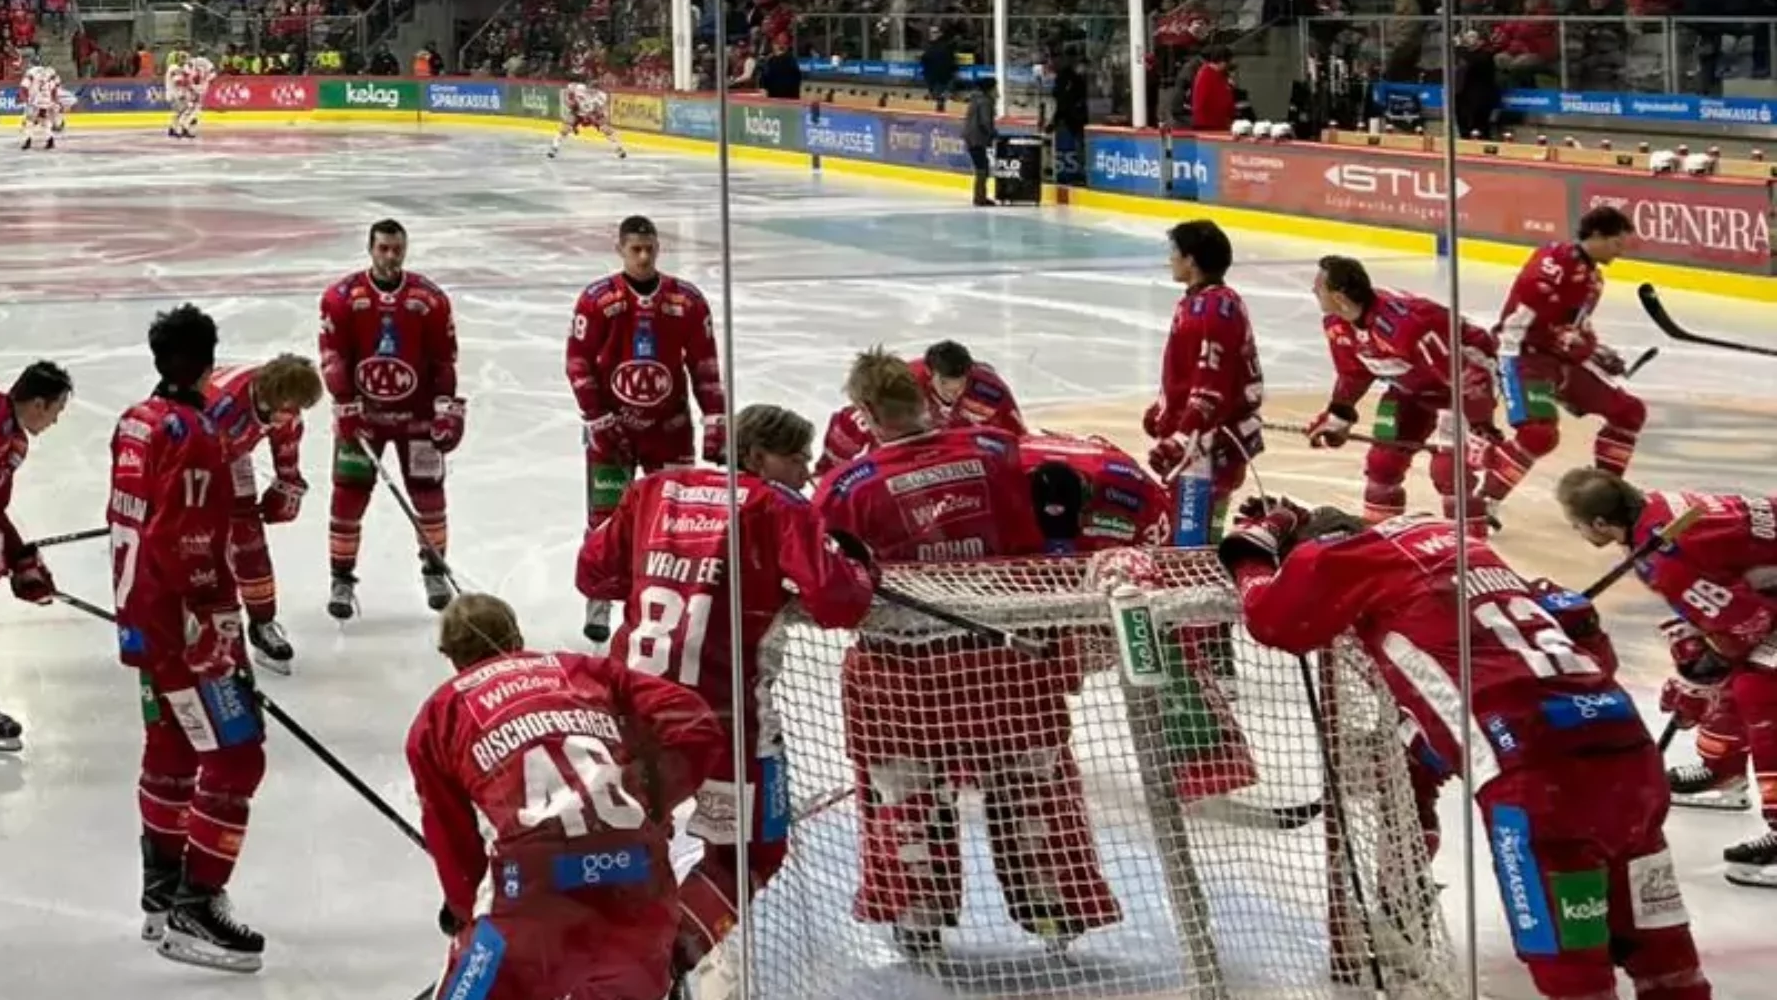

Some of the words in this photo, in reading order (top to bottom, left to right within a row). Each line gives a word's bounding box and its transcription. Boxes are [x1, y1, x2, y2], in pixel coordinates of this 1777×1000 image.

[345, 83, 399, 107] kelag
[1699, 106, 1757, 122] SPARKASSE
[744, 105, 782, 144] kelag
[1341, 164, 1450, 200] STW
[182, 468, 212, 508] 17
[627, 585, 714, 687] 81
[1135, 604, 1154, 675] kelag
